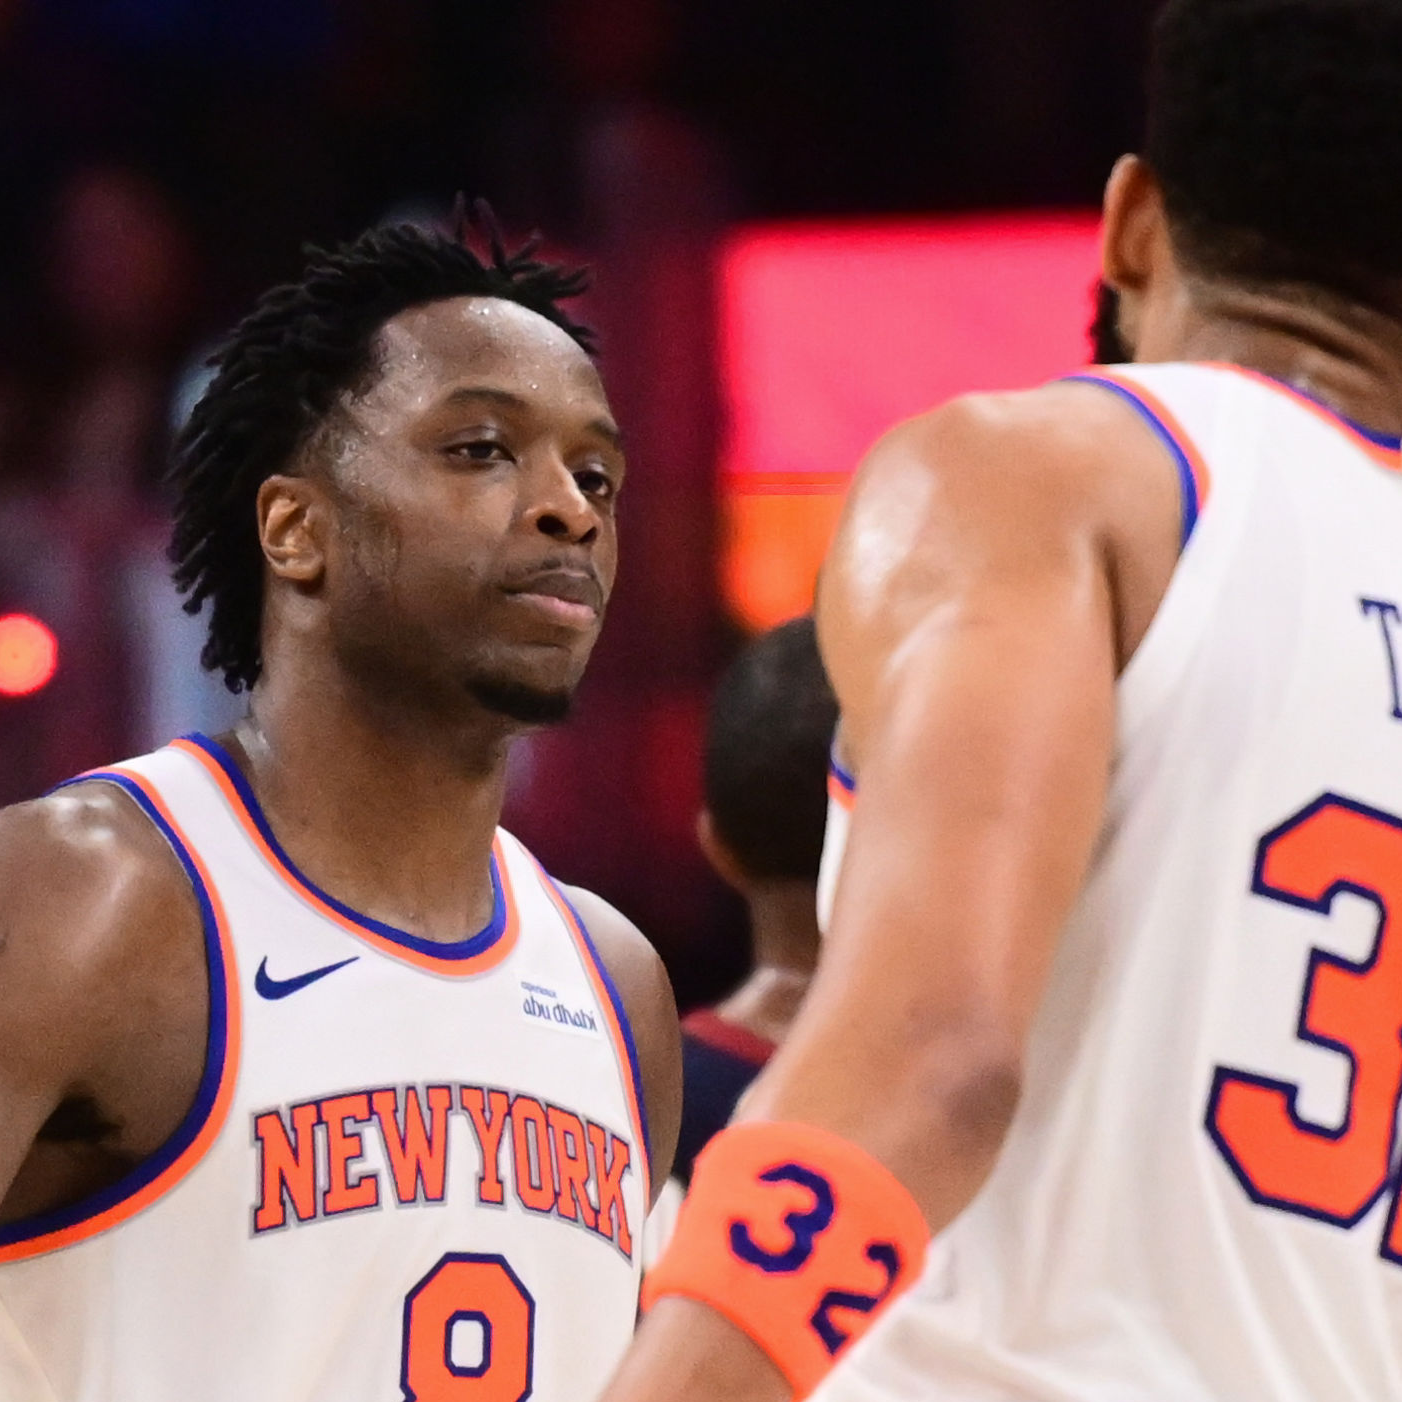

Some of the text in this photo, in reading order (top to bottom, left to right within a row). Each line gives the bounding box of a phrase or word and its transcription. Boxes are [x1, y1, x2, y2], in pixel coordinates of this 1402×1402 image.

[523, 995, 598, 1033] abu dhabi
[250, 1082, 635, 1268] NEW YORK
[729, 1163, 900, 1357] 32
